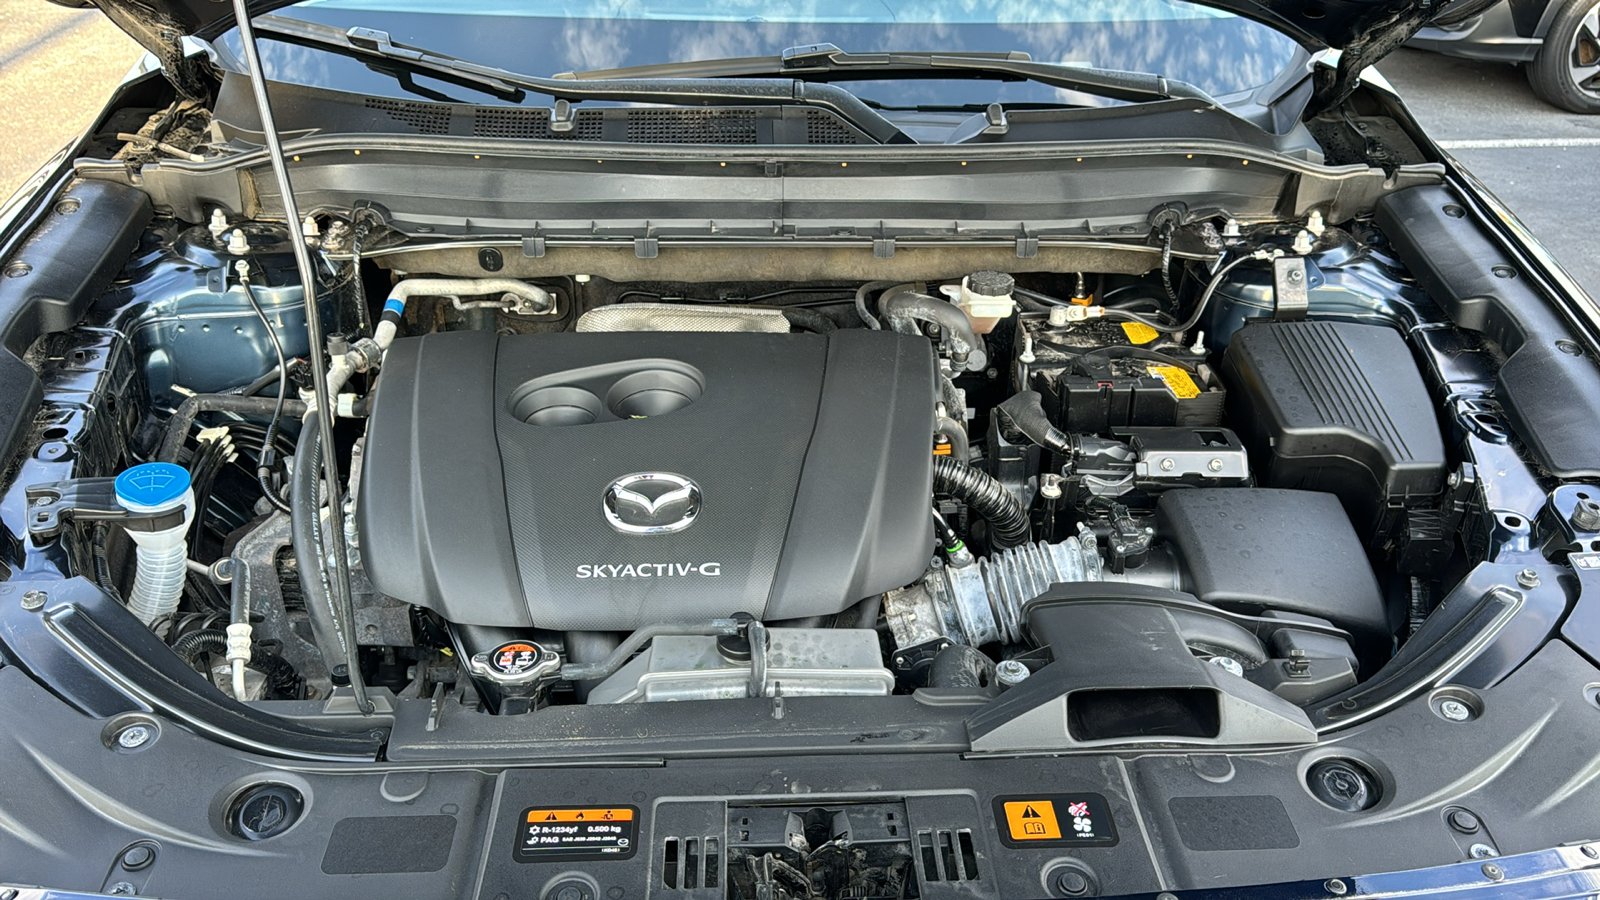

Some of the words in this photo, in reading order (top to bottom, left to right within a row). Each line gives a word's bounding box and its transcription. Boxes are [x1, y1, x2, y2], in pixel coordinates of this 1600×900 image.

[311, 511, 320, 541] GALAXY
[576, 562, 721, 578] SKYACTIV-G
[540, 836, 559, 844] PAG
